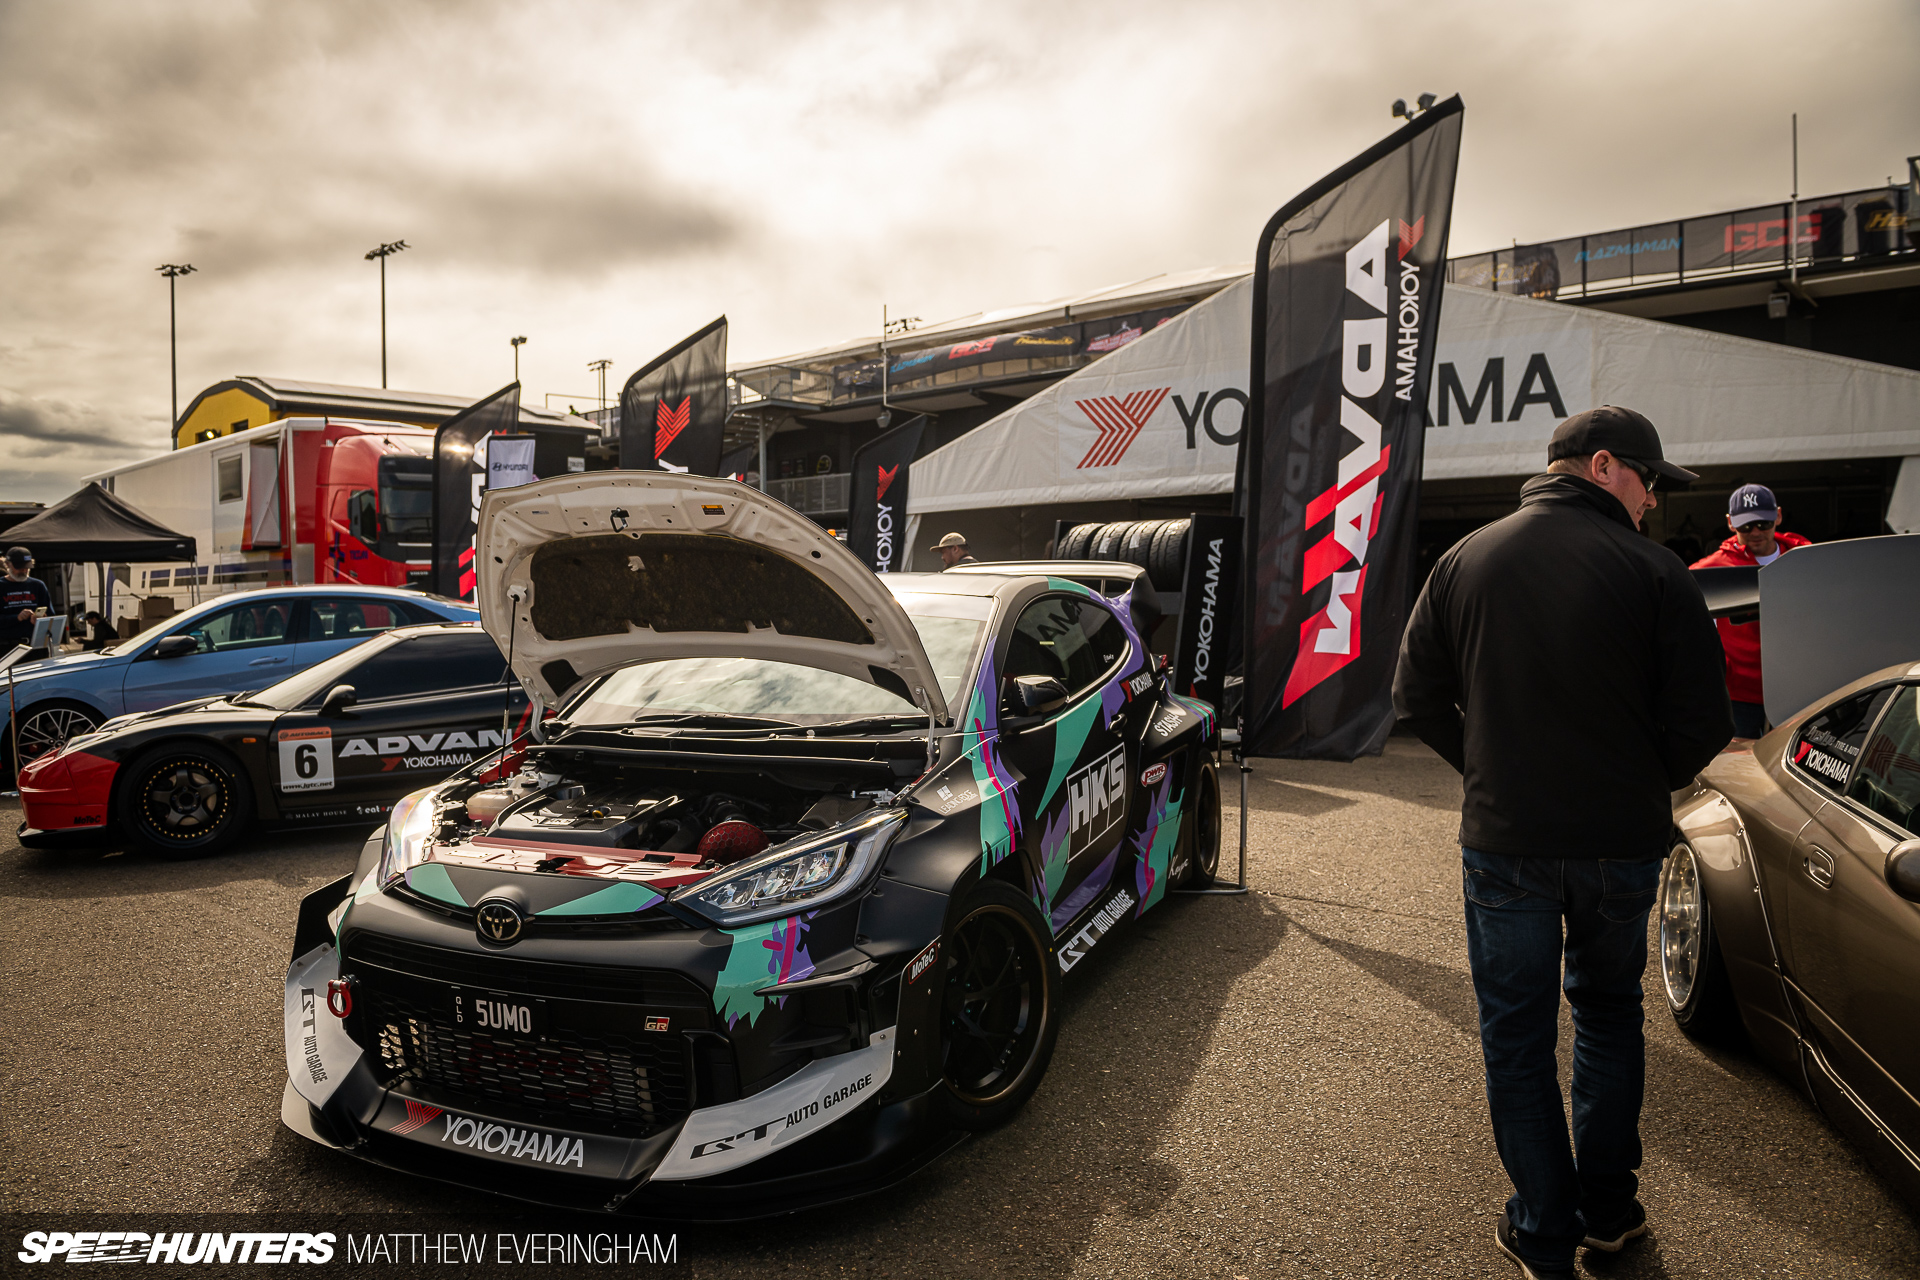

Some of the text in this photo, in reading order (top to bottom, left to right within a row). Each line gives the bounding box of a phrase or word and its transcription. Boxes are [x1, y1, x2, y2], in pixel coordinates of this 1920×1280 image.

[1724, 212, 1823, 254] GCG
[1574, 236, 1683, 264] PLAZMAMAN
[1193, 538, 1224, 684] YOKOHAMA
[1153, 713, 1183, 737] STASH
[338, 728, 514, 758] ADVAN
[294, 743, 319, 780] 6
[403, 752, 474, 770] YOKOHAMA
[1145, 765, 1165, 784] PWR
[1805, 747, 1852, 784] YOKOHAMA
[1070, 752, 1125, 834] HKS
[323, 809, 348, 817] HOUSE
[364, 804, 380, 814] eat
[1091, 909, 1116, 935] AUTO
[1105, 888, 1135, 920] GARAGE
[911, 946, 935, 980] MoTeC
[645, 1021, 668, 1031] GR
[304, 1035, 318, 1056] AUTO
[306, 1054, 328, 1085] GARAGE
[785, 1101, 819, 1129] AUTO
[823, 1073, 872, 1110] GARAGE
[441, 1114, 584, 1168] YOKOHAMA
